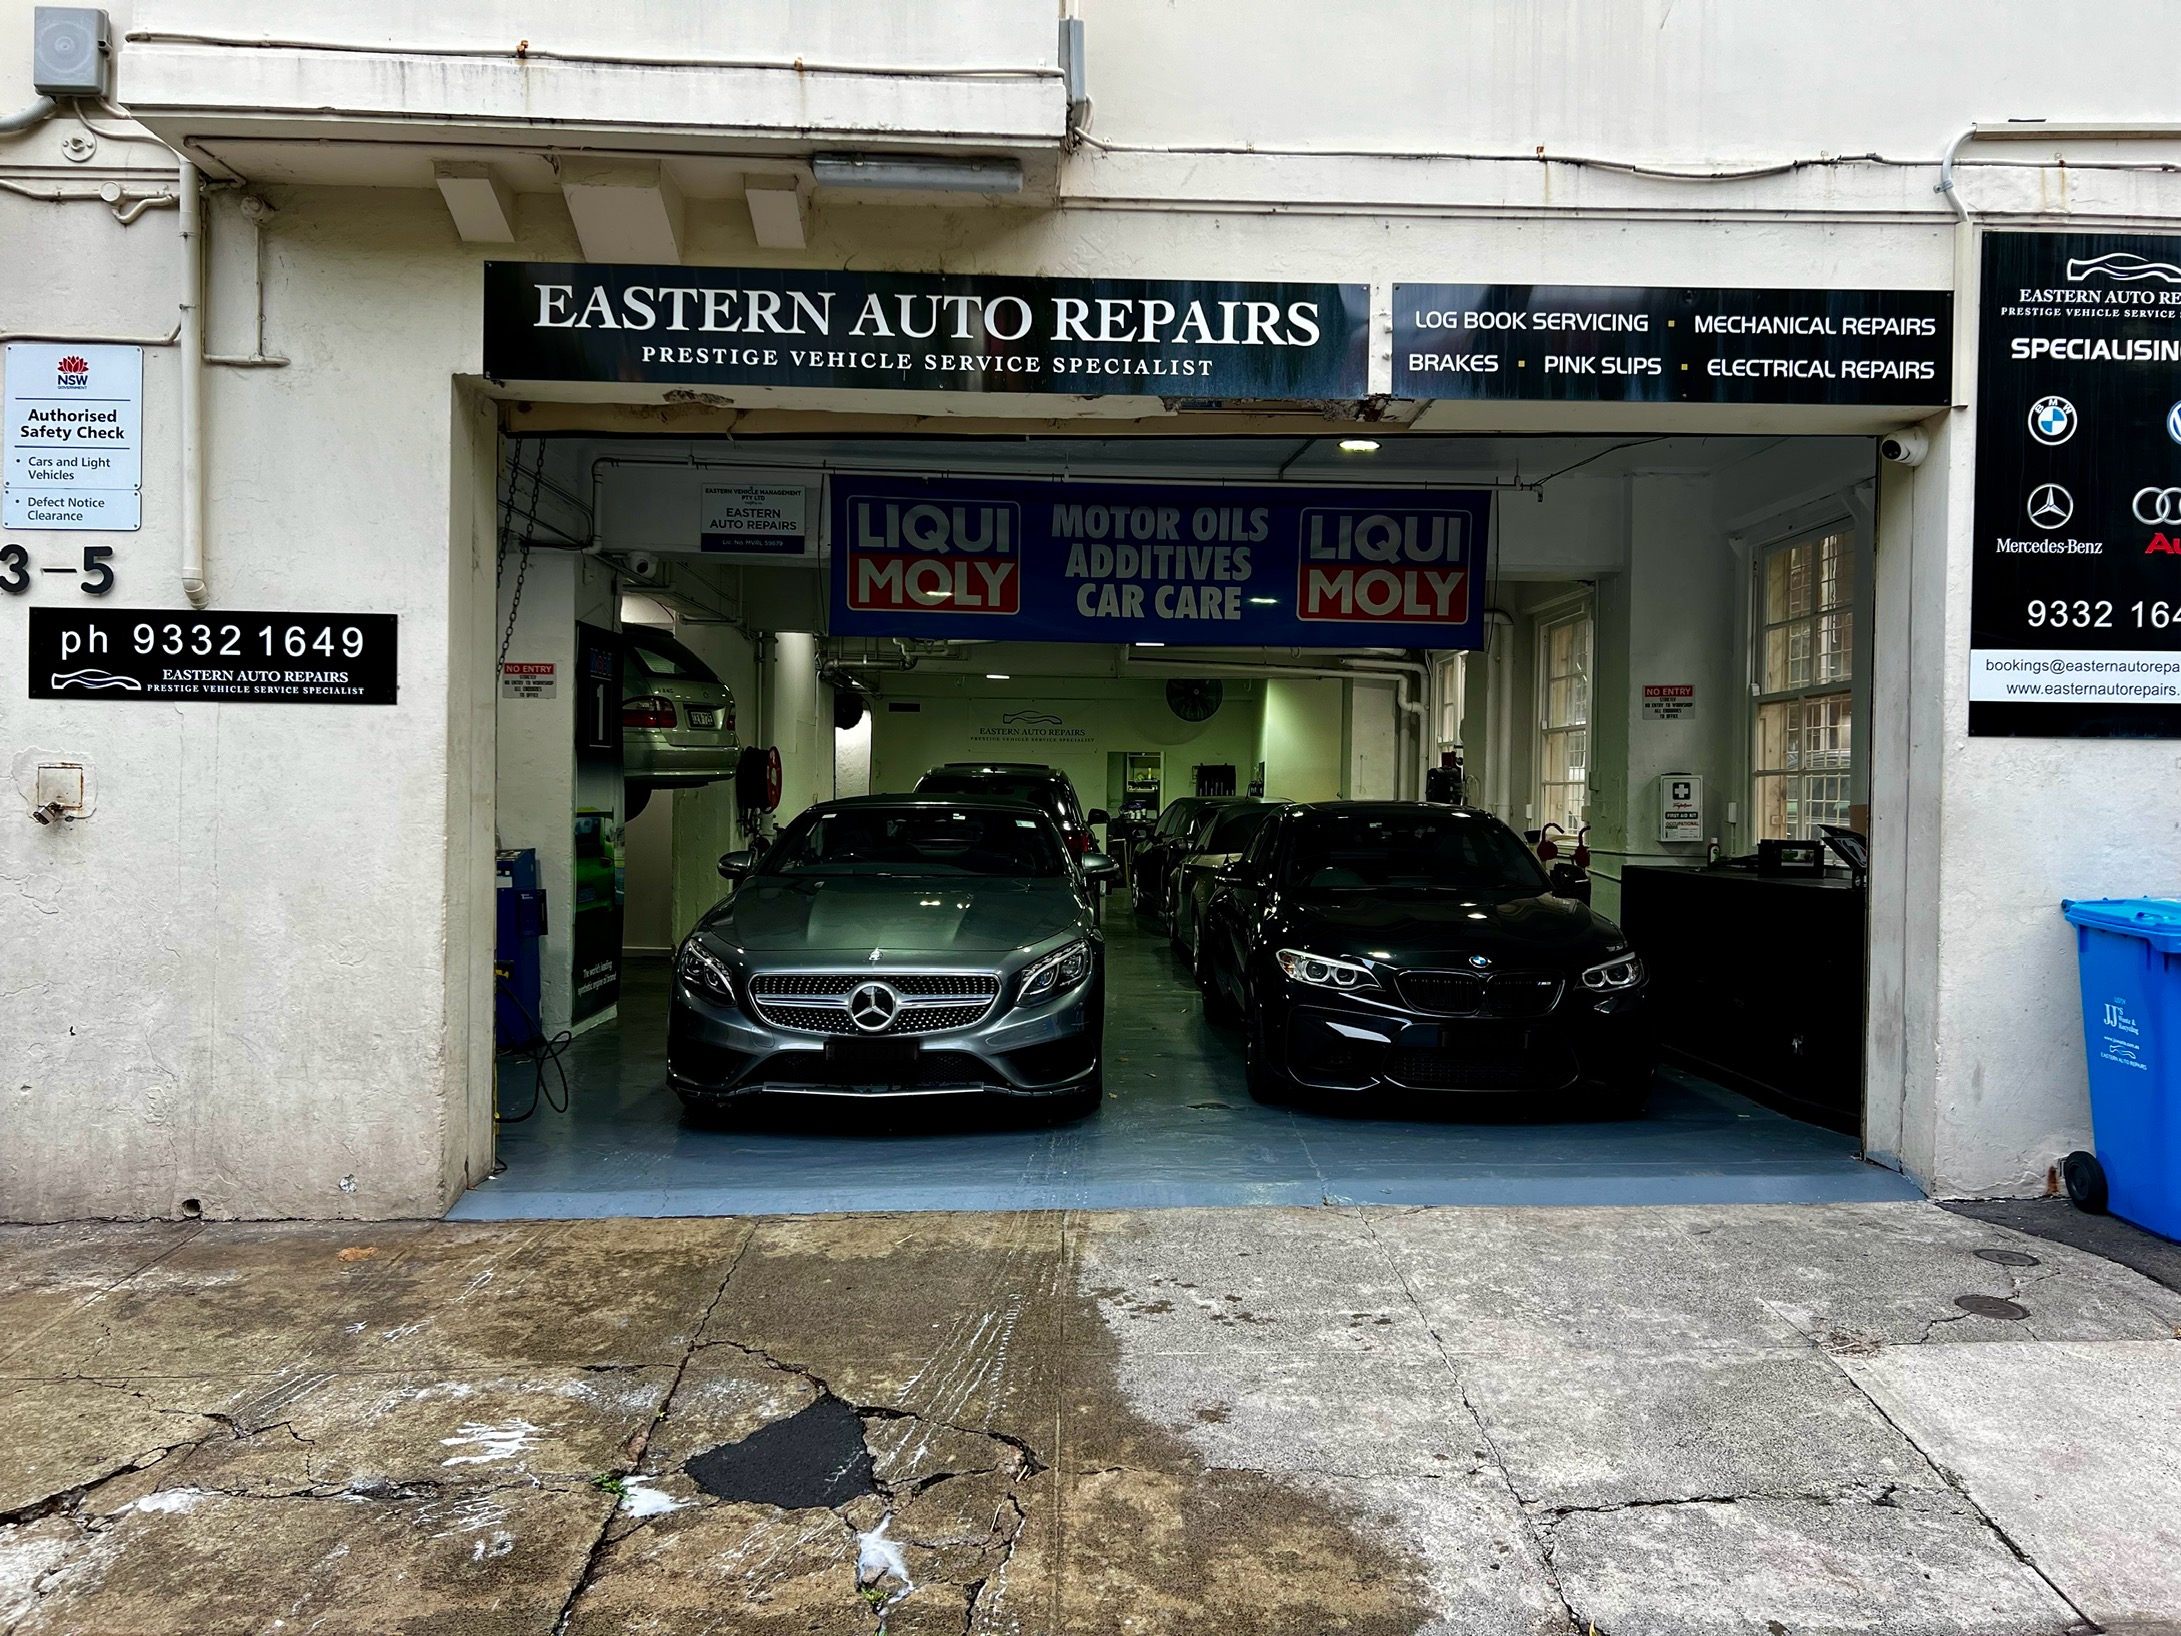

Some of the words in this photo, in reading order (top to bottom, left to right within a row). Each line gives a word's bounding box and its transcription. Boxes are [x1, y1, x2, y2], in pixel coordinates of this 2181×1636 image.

[2020, 288, 2102, 303] EASTERN
[2104, 290, 2155, 304] AUTO
[533, 283, 836, 336] EASTERN
[848, 292, 1033, 340] AUTO
[1050, 298, 1321, 346] REPAIRS
[2001, 307, 2062, 316] PRESTIGE
[2066, 308, 2120, 317] VEHICLE
[2124, 309, 2176, 318] SERVICE
[1415, 311, 1461, 329] LOG
[1464, 312, 1527, 330] BOOK
[1532, 312, 1649, 332] SERVICING
[1694, 315, 1837, 335] MECHANICAL
[1842, 317, 1936, 336] REPAIRS
[2011, 337, 2181, 361] SPECIALISIN
[642, 346, 778, 366] PRESTIGE
[790, 350, 912, 370] VEHICLE
[924, 354, 1040, 373] SERVICE
[1053, 356, 1213, 376] SPECIALIST
[1408, 353, 1499, 372] BRAKES
[1544, 355, 1596, 374] PINK
[1601, 356, 1662, 375] SLIPS
[1706, 358, 1836, 379] ELECTRICAL
[1841, 359, 1935, 380] REPAIRS
[57, 375, 88, 385] NSW
[28, 408, 117, 422] Authorised
[20, 425, 72, 441] Safety
[77, 426, 125, 439] Check
[28, 457, 53, 467] Cars
[56, 457, 78, 467] and
[81, 457, 111, 470] Light
[28, 470, 75, 480] Vehicles
[27, 497, 65, 507] Defect
[68, 497, 105, 508] Notice
[27, 510, 84, 521] Clearance
[726, 507, 781, 518] EASTERN
[709, 519, 744, 529] AUTO
[747, 520, 797, 531] REPAIRS
[857, 501, 1010, 554] LIQUI
[1052, 503, 1184, 540] MOTOR
[1192, 506, 1270, 542] OILS
[1308, 512, 1461, 565] LIQUI
[1996, 538, 2103, 554] Mercedes-Benz
[1065, 543, 1252, 581] ADDITIVES
[858, 558, 1016, 606] MOLY
[1308, 568, 1466, 617] MOLY
[1076, 583, 1145, 618] CAR
[1154, 585, 1242, 620] CARE
[2027, 600, 2113, 628] 9332
[61, 624, 108, 660] ph
[133, 623, 241, 656] 9332
[259, 625, 364, 658] 1649
[162, 669, 235, 681] EASTERN
[236, 670, 281, 682] AUTO
[284, 671, 349, 683] REPAIRS
[506, 665, 520, 673] NO
[522, 665, 552, 673] ENTRY
[147, 684, 199, 692] PRESTIGE
[202, 685, 250, 693] VEHICLE
[254, 686, 299, 694] SERVICE
[302, 686, 365, 695] SPECIALIST
[1646, 688, 1660, 696] NO
[1662, 687, 1691, 696] ENTRY
[980, 727, 1020, 735] EASTERN
[1021, 728, 1047, 736] AUTO
